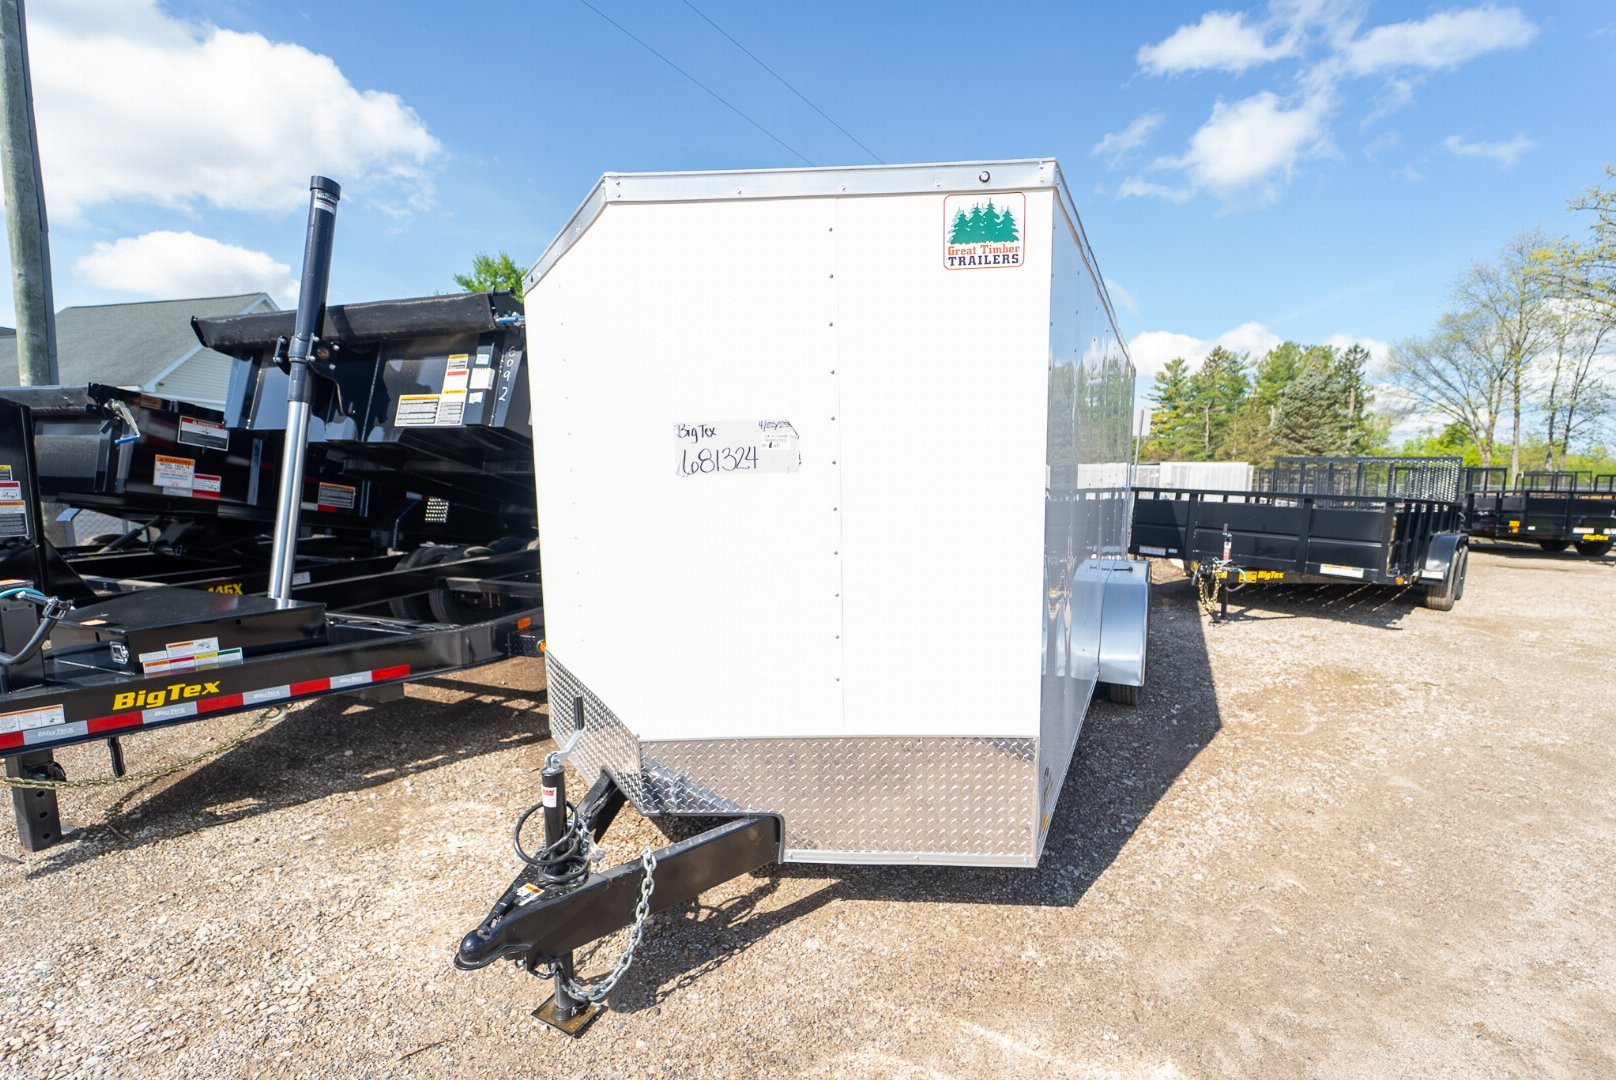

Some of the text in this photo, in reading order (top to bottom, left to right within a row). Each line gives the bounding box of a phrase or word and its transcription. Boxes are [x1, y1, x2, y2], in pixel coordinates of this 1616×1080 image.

[947, 244, 1020, 256] Great Timber
[948, 253, 1019, 266] TRAILERS
[682, 446, 759, 475] 681324
[112, 680, 221, 711] BigTex
